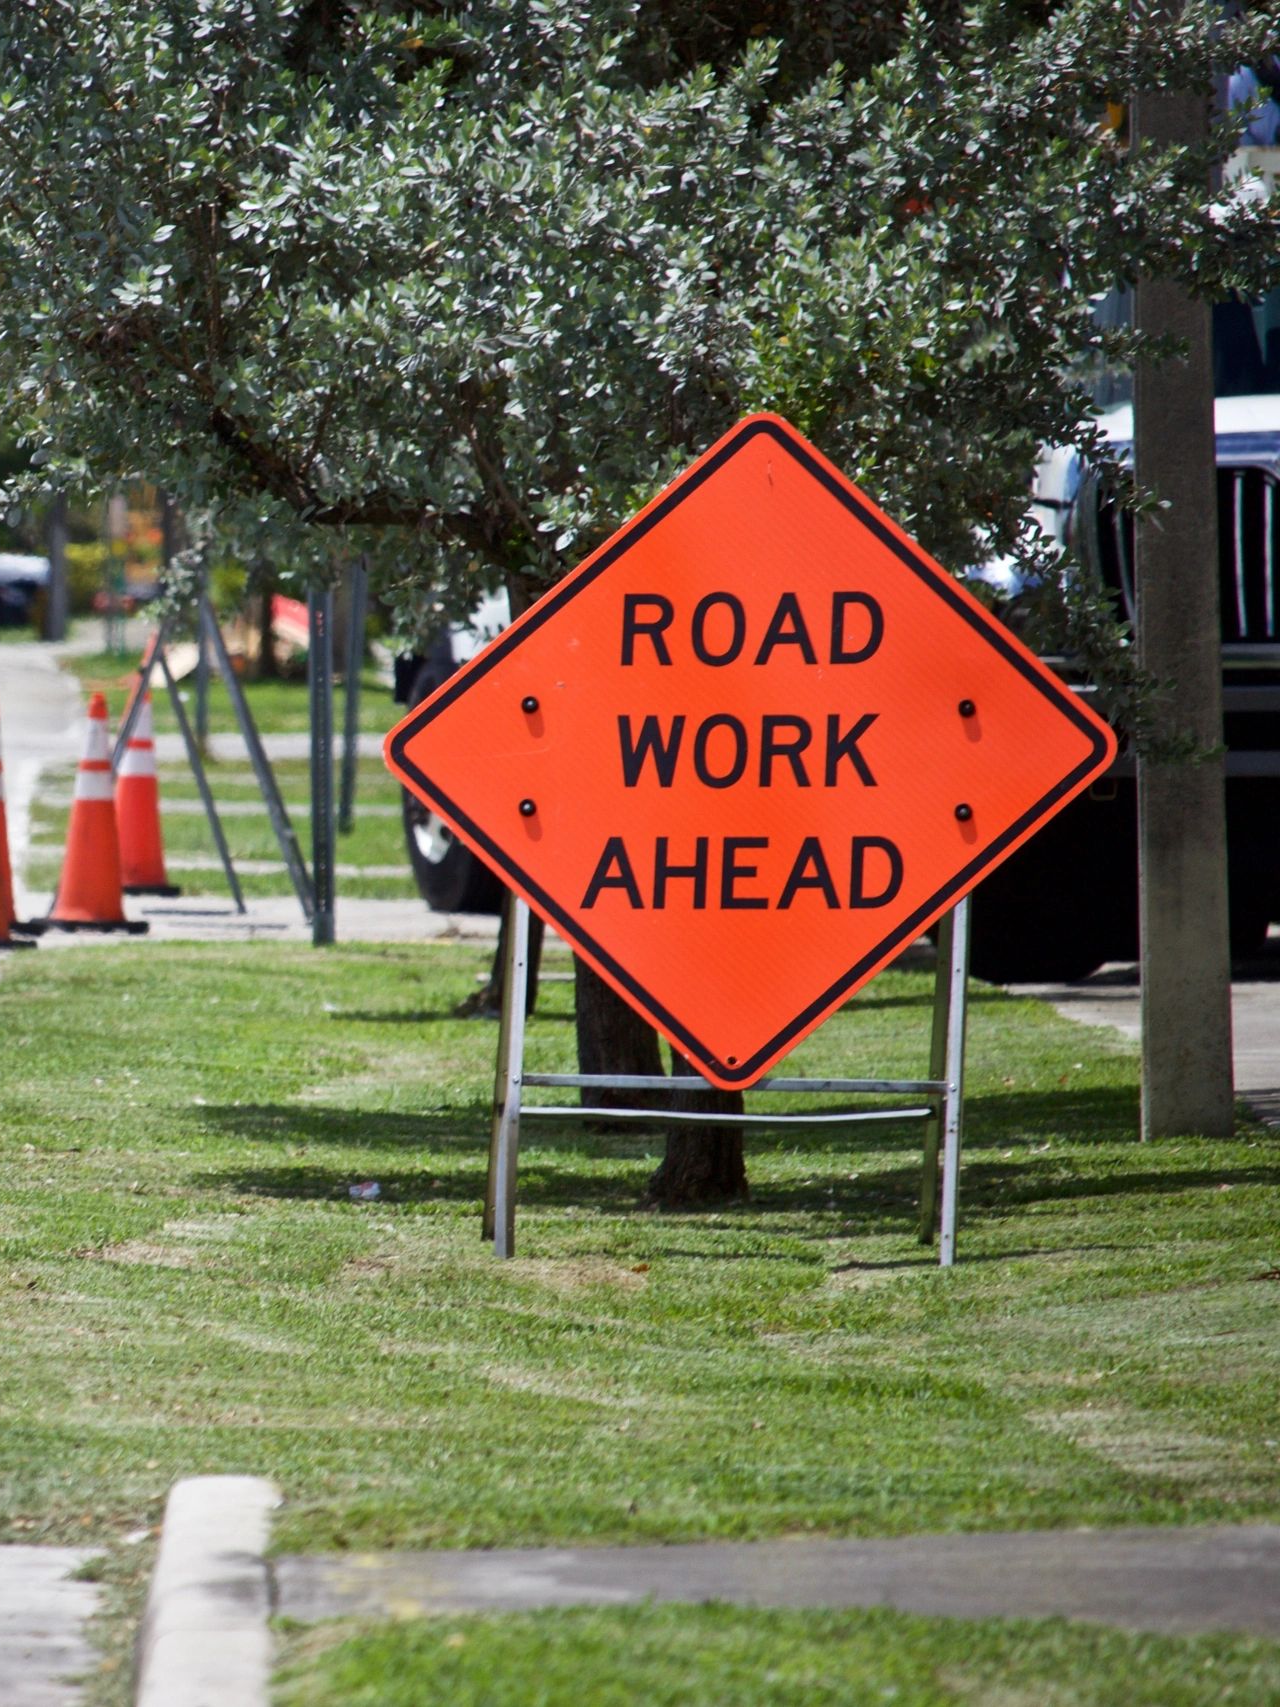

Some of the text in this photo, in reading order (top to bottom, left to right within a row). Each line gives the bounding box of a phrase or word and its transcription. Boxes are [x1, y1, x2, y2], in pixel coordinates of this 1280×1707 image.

[621, 591, 885, 667] ROAD
[617, 713, 879, 789] WORK
[580, 836, 904, 910] AHEAD
